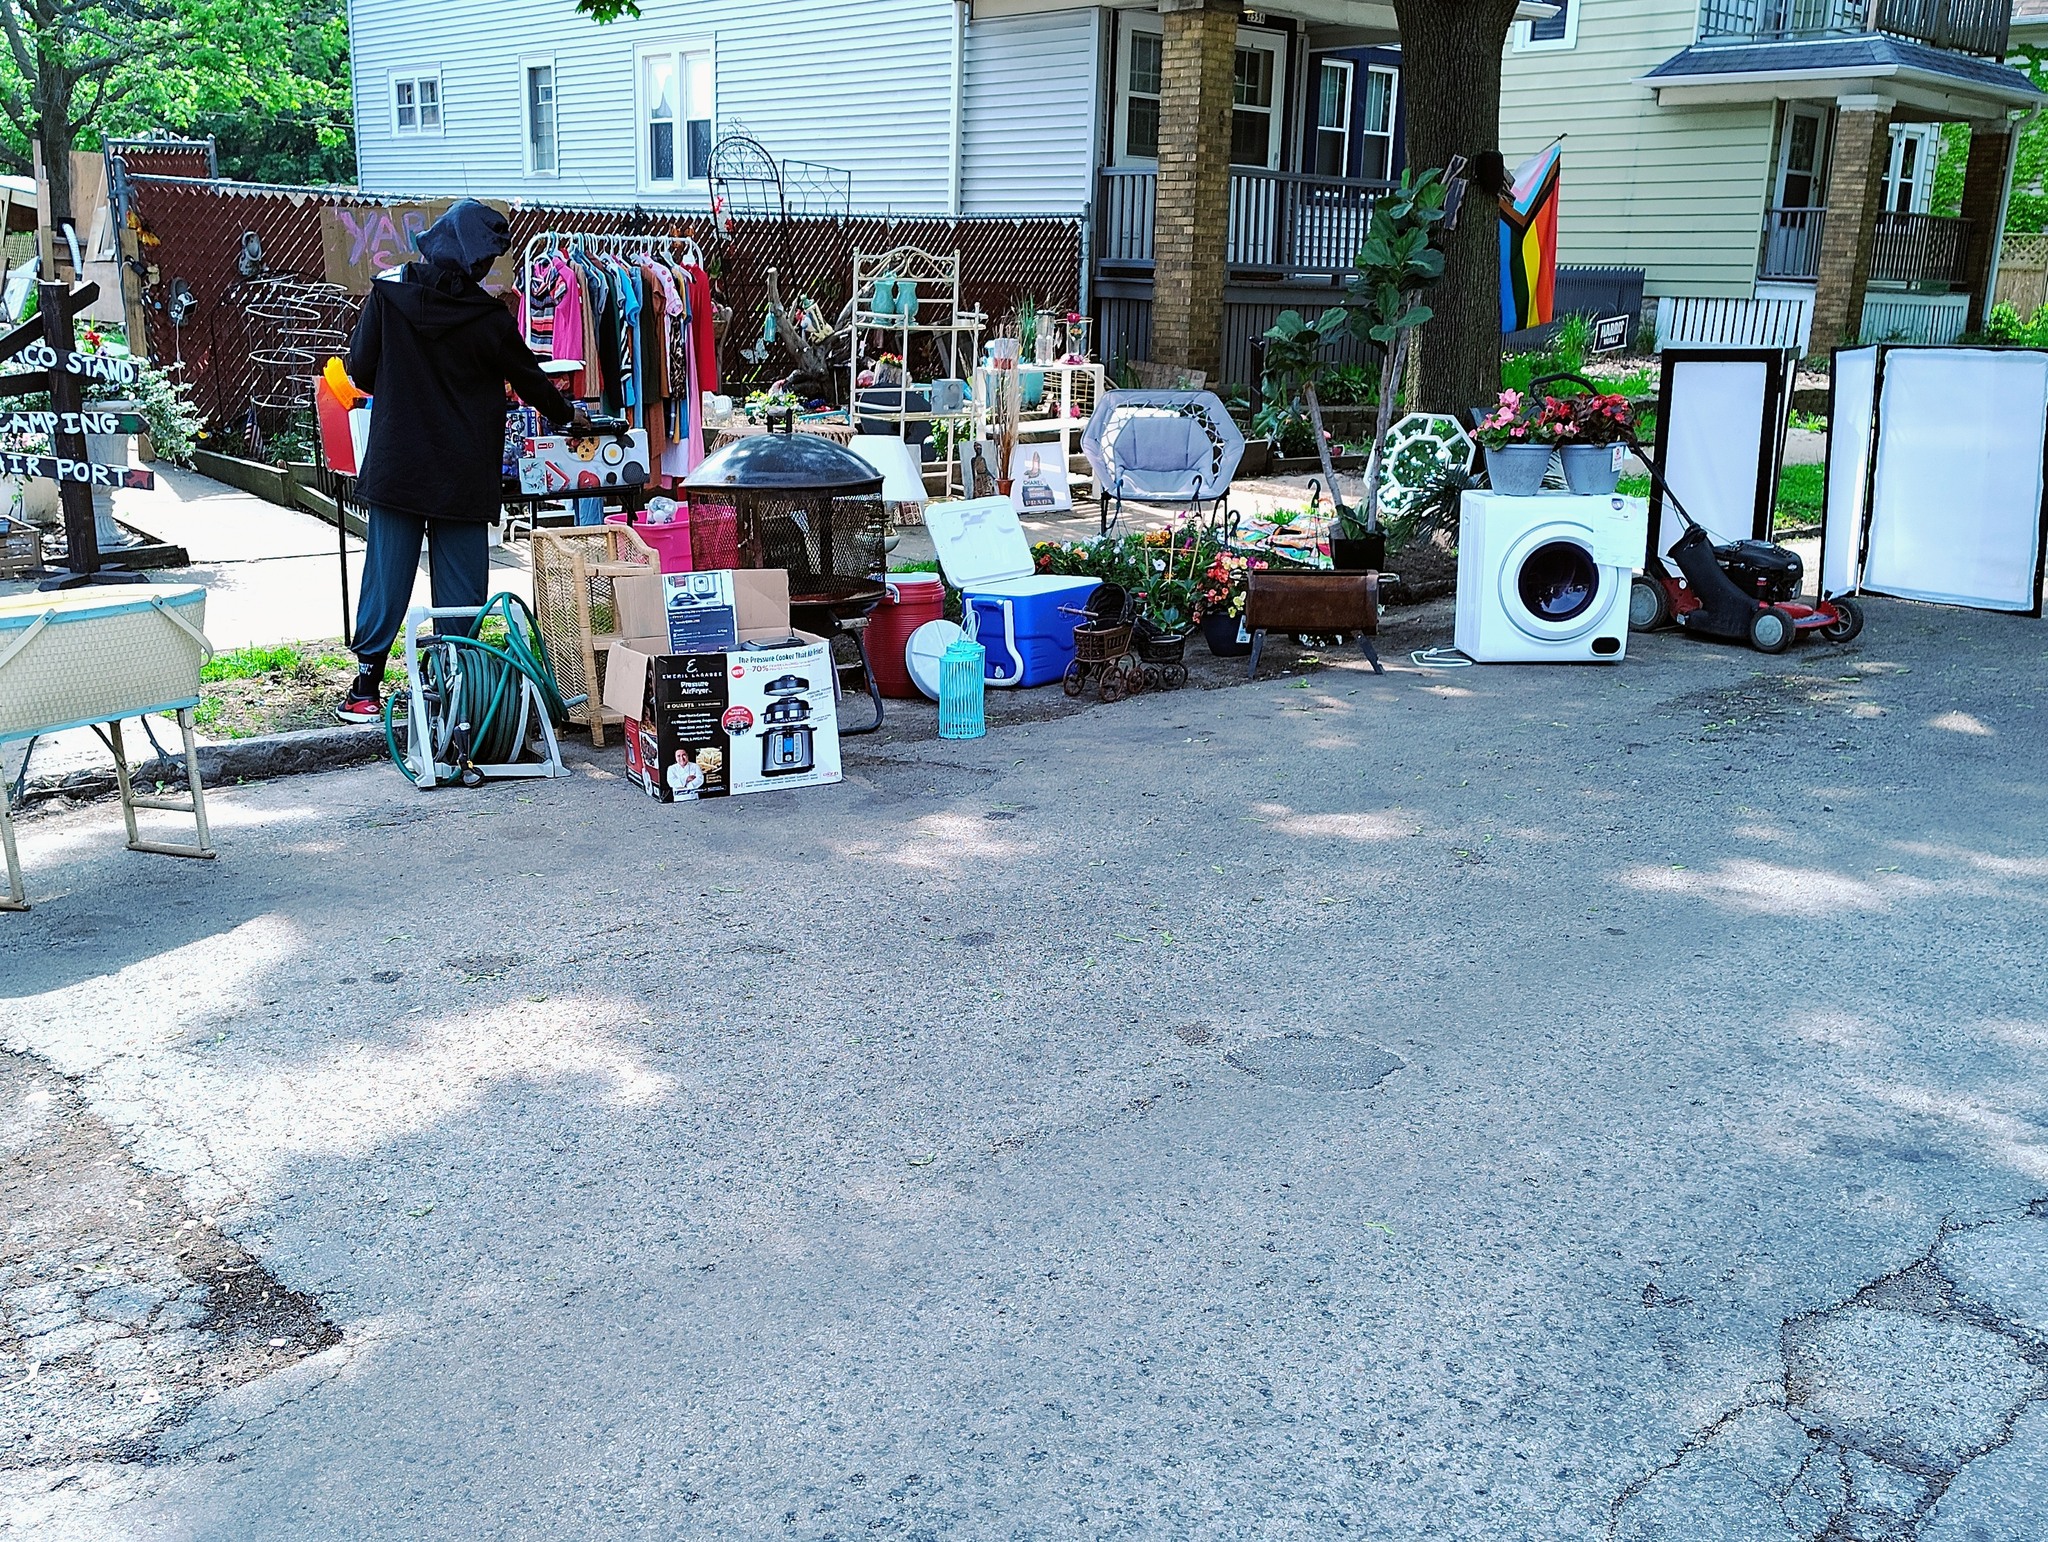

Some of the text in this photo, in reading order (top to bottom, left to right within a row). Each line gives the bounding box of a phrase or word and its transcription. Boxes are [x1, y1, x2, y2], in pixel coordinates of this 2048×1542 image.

[338, 210, 440, 266] YAR
[66, 355, 135, 384] STAND
[0, 411, 119, 434] CAMPING
[57, 459, 131, 486] PORT
[750, 655, 775, 664] Pressure
[776, 653, 795, 662] Cooker
